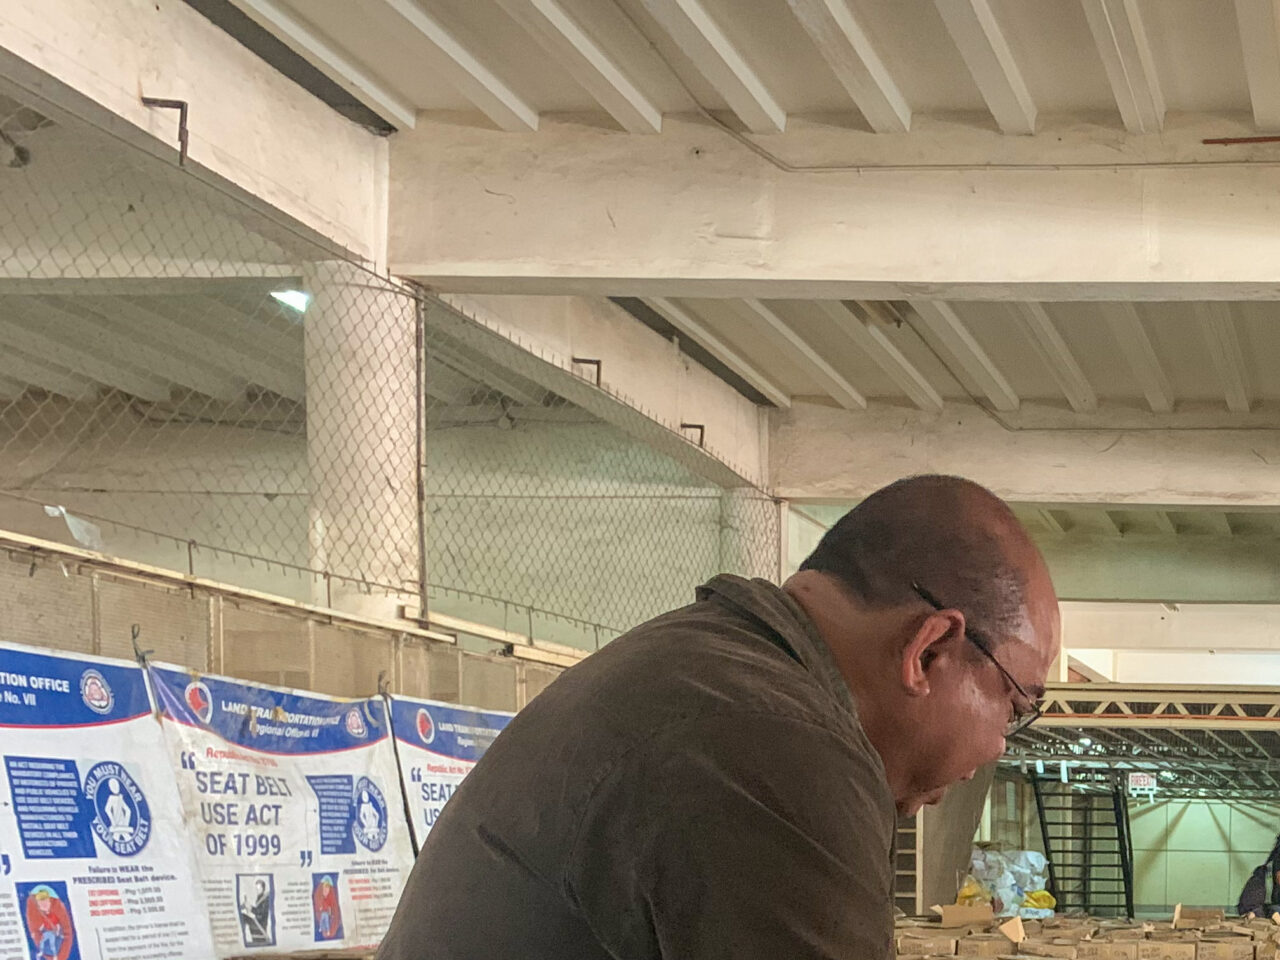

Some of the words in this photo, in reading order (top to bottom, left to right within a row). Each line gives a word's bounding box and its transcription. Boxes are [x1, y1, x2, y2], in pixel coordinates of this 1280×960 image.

[30, 676, 70, 693] OFFICE
[4, 690, 21, 704] No.
[23, 692, 37, 706] VII
[221, 700, 247, 716] LAND
[85, 776, 97, 800] YOU
[92, 763, 120, 780] MUST
[120, 769, 144, 803] WEAR
[195, 771, 250, 795] SEAT
[255, 774, 293, 797] BELT
[421, 782, 453, 802] SEAT
[200, 802, 239, 825] USE
[245, 804, 283, 826] ACT
[92, 815, 114, 847] YOUR
[113, 840, 136, 854] SEAT
[134, 816, 150, 848] BELT
[205, 833, 227, 856] OF
[233, 834, 282, 857] 1999
